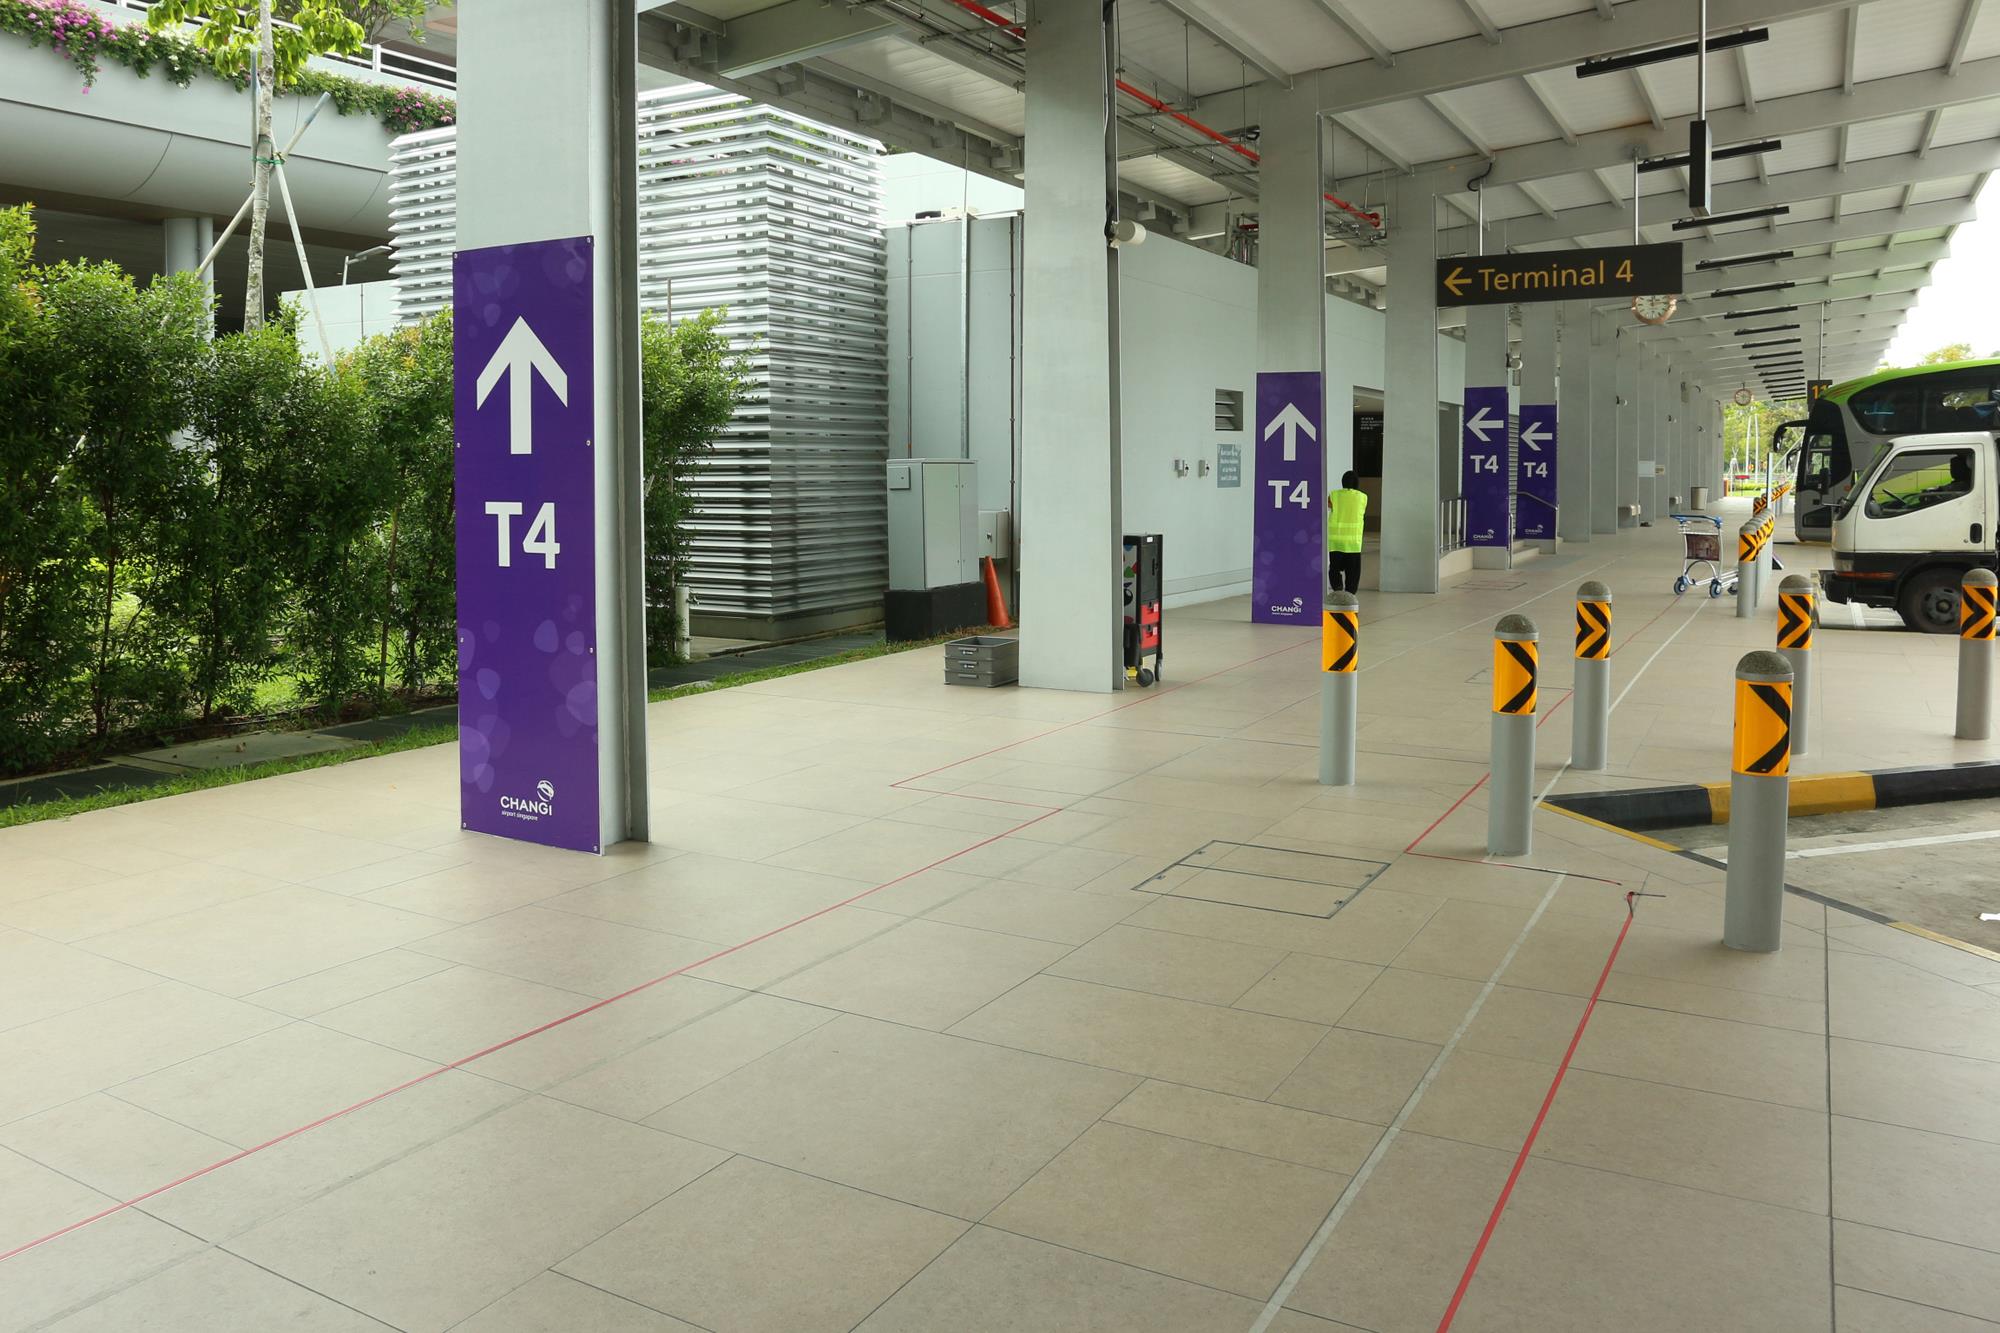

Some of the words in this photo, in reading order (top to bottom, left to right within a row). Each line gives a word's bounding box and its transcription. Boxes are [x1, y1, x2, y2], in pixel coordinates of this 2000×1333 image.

[1478, 260, 1605, 291] Terminal
[1615, 259, 1634, 284] 4
[1470, 455, 1499, 474] T4
[1523, 462, 1548, 478] T4
[1267, 480, 1311, 509] T4
[485, 501, 561, 569] T4
[1271, 605, 1302, 613] CHANGI
[500, 795, 552, 816] CHANGI
